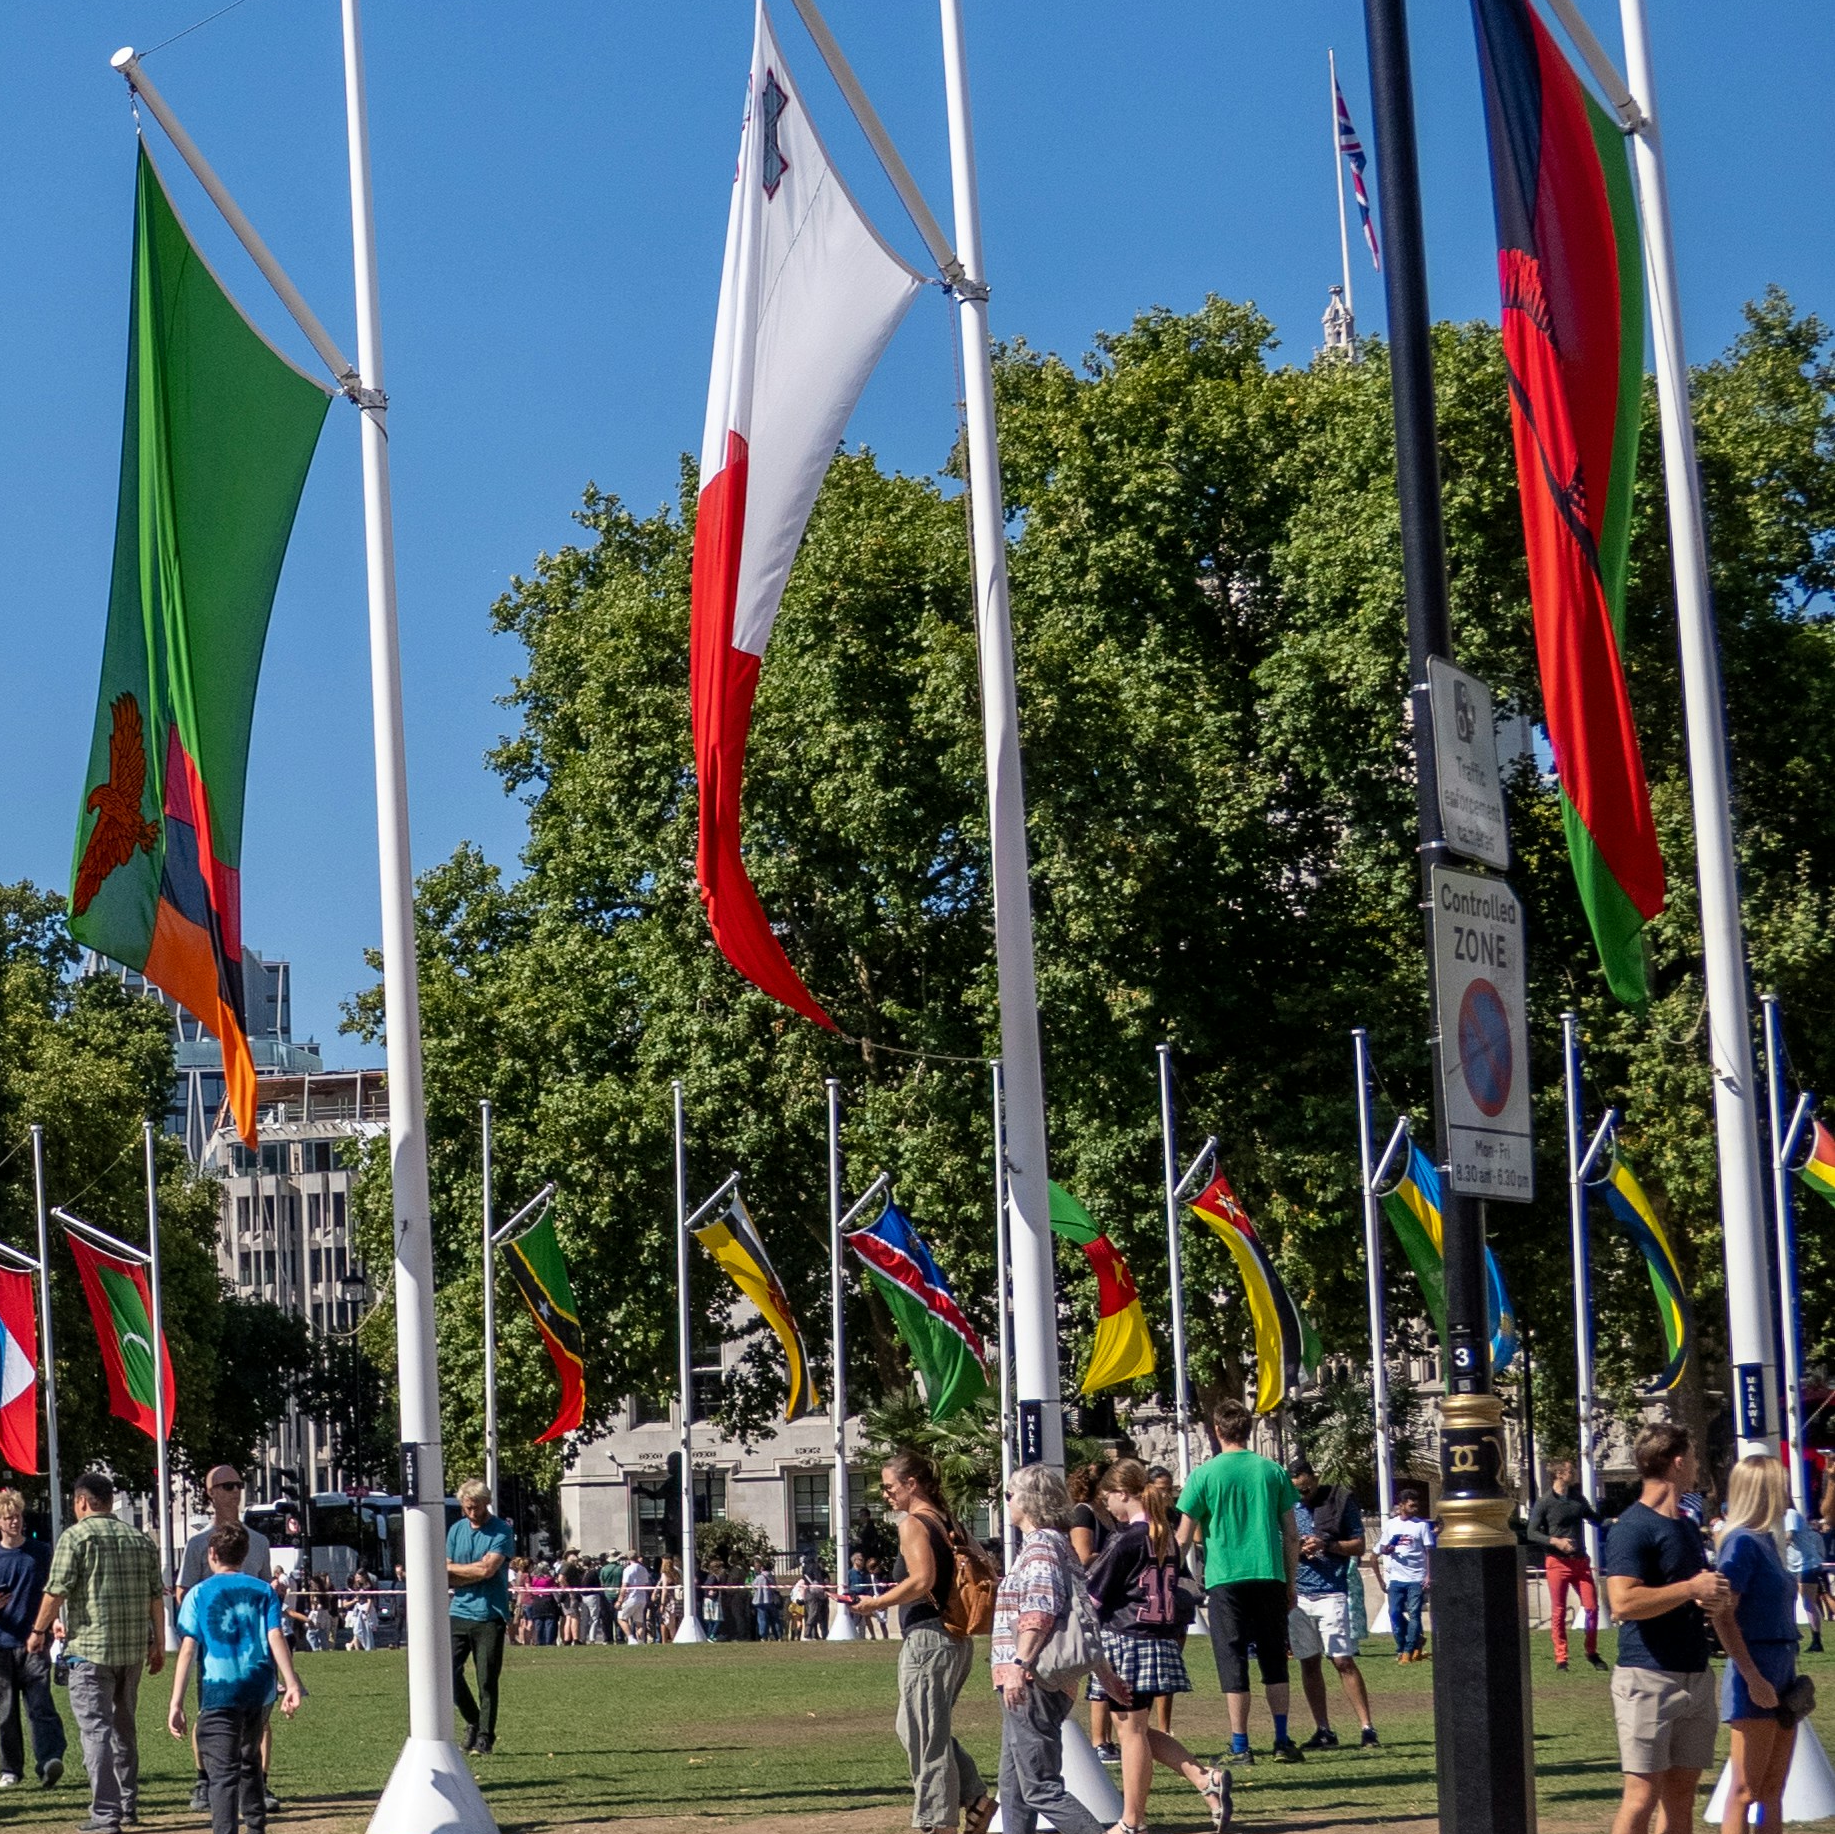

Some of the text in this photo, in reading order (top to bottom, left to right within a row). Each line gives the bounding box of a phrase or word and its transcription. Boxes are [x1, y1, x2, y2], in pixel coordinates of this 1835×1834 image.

[1456, 756, 1486, 787] Traffic
[1441, 883, 1516, 925] Controlled
[1453, 926, 1507, 969] ZONE
[1454, 1348, 1469, 1366] 3
[1745, 1376, 1758, 1427] MALAWI
[1027, 1415, 1035, 1453] MALTA
